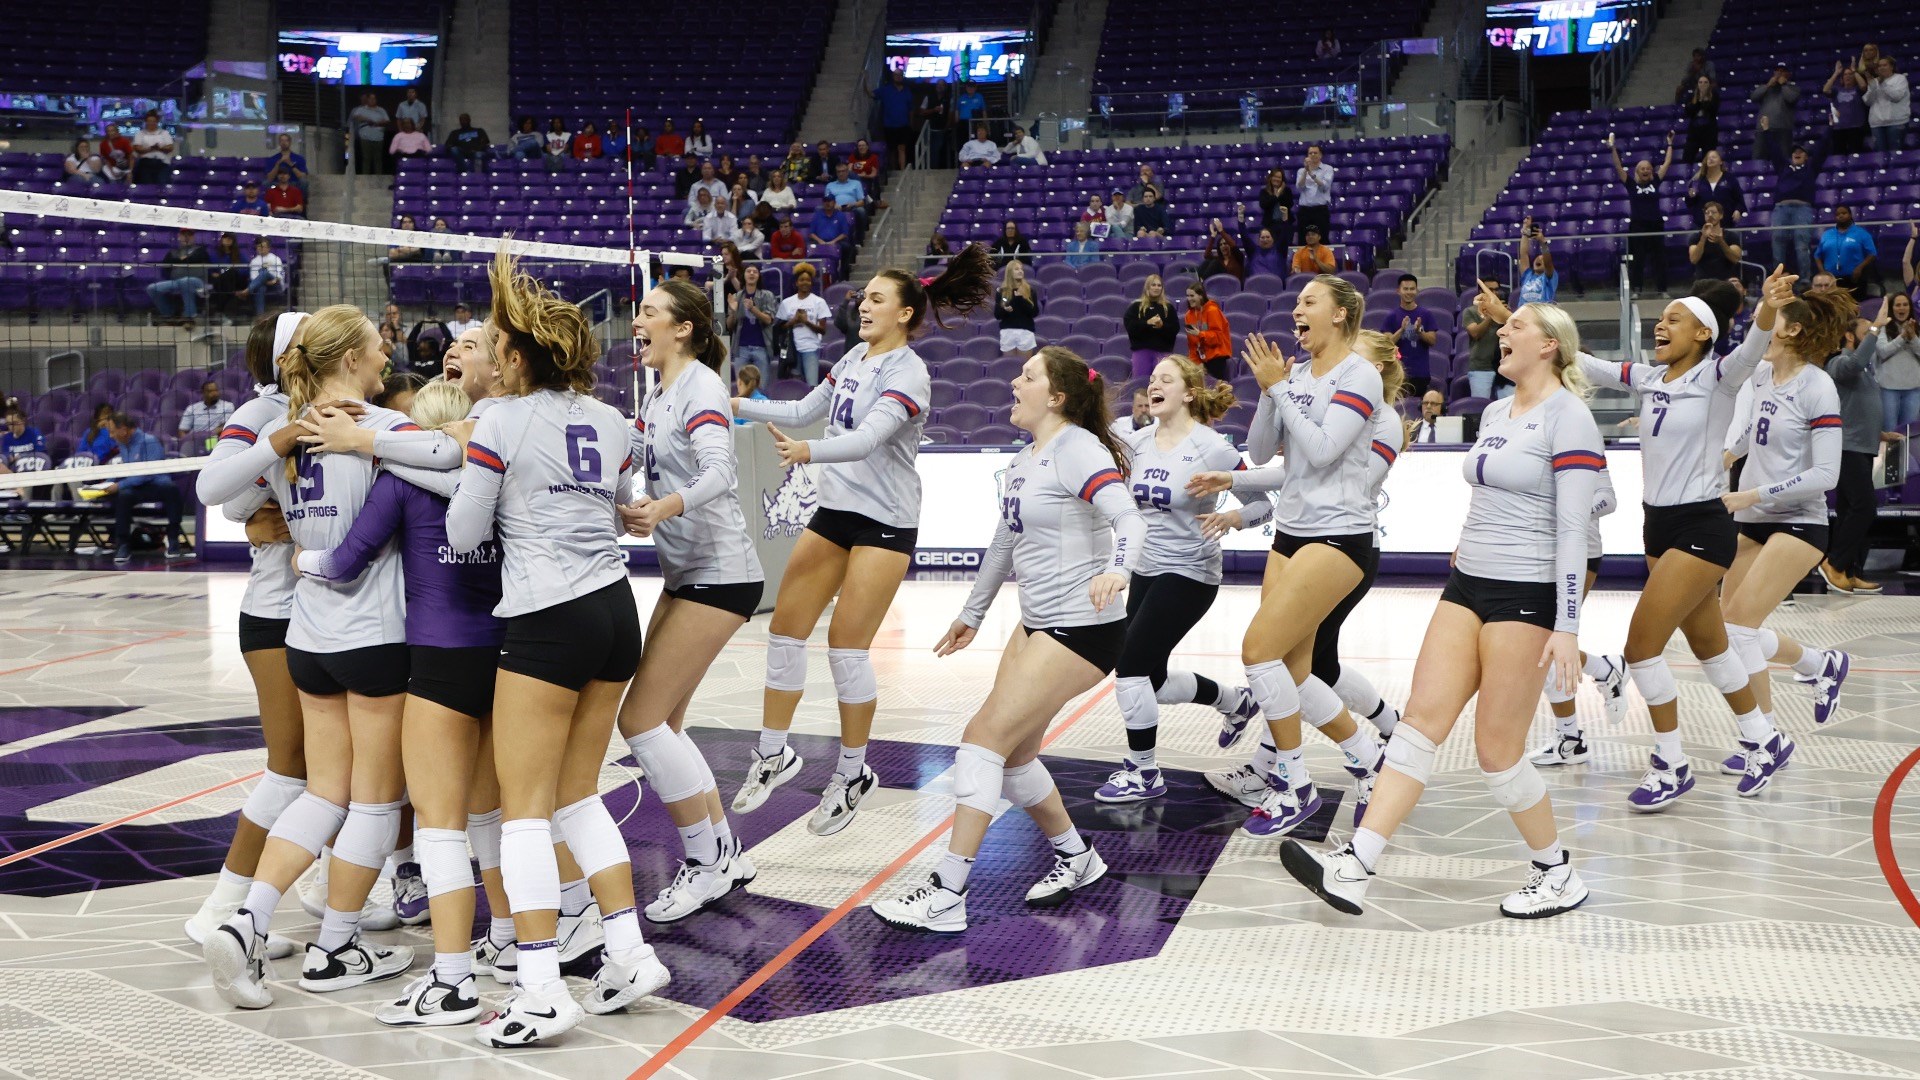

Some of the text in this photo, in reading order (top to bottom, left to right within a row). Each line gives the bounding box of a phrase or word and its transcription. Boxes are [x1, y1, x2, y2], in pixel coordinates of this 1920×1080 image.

[1538, 2, 1597, 20] KILLS
[1512, 27, 1549, 50] 57
[311, 56, 348, 78] 45
[383, 58, 421, 79] 45
[841, 377, 859, 393] TCU
[830, 394, 854, 429] 14
[1760, 400, 1778, 415] TCU
[1652, 408, 1667, 437] 7
[1756, 416, 1770, 446] 8
[1479, 436, 1508, 449] TCU
[64, 457, 94, 469] TCU
[565, 424, 602, 483] 6
[16, 457, 46, 472] TCU
[1476, 453, 1488, 485] 1
[1143, 468, 1170, 482] TCU
[1785, 475, 1802, 488] BAH
[1133, 484, 1172, 512] 22
[308, 506, 338, 518] FROGS
[915, 551, 980, 566] GEICO
[1566, 573, 1576, 619] BAH ZOO
